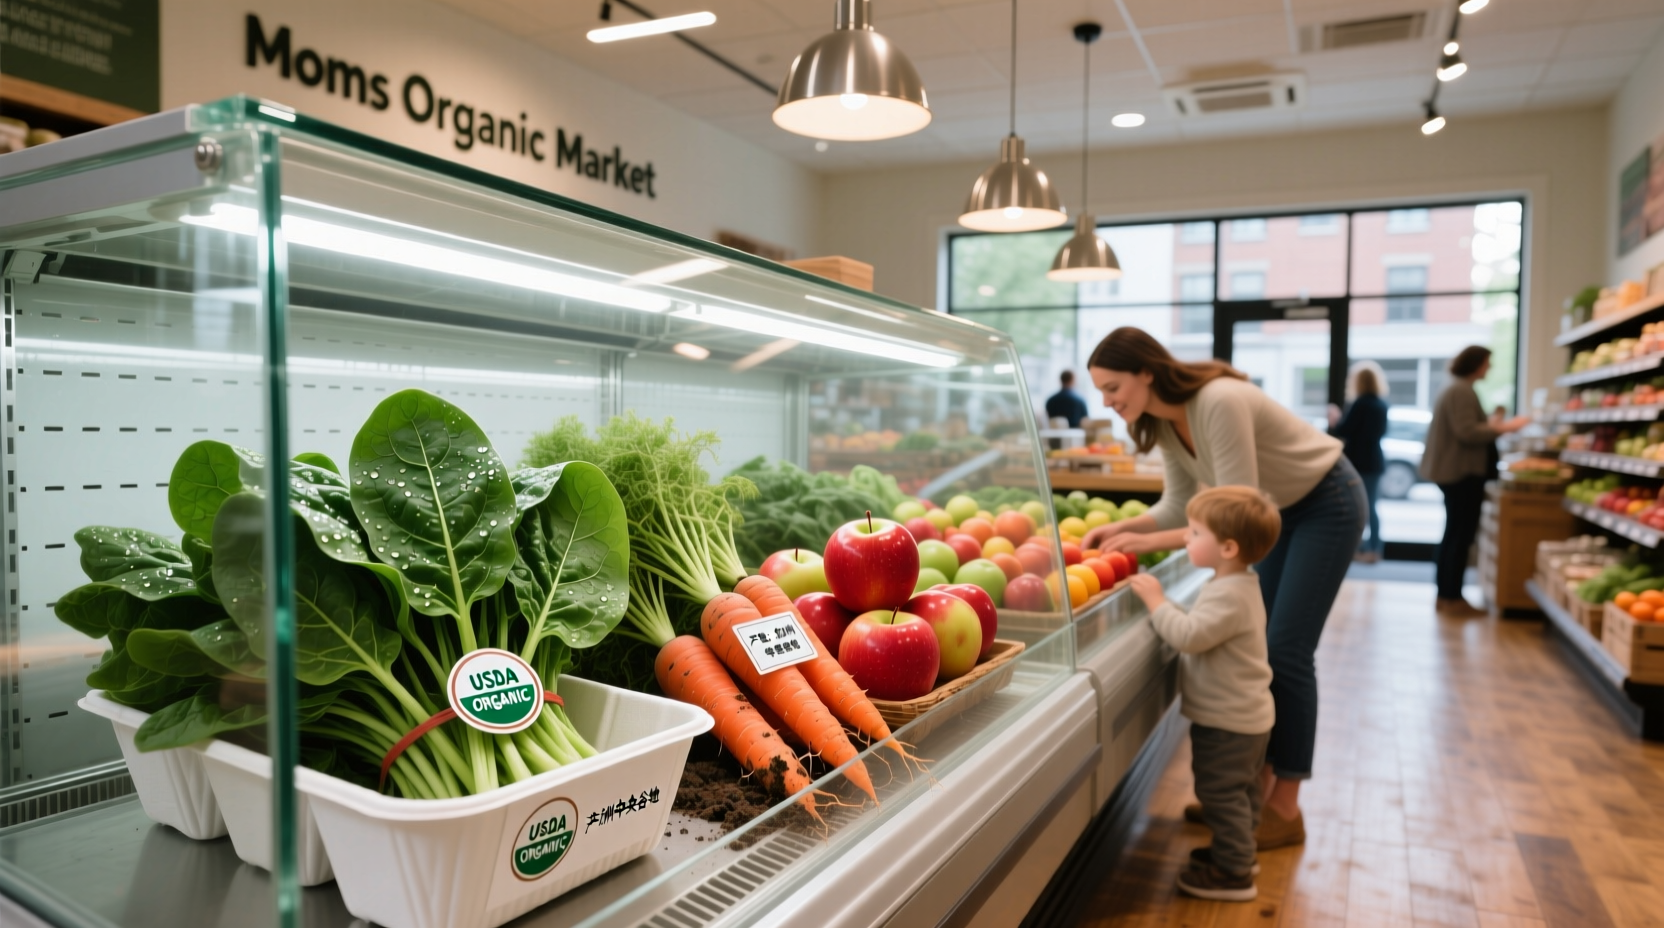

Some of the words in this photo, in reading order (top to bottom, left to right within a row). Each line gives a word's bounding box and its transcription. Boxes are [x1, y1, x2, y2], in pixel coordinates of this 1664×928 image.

[244, 12, 391, 112] Moms
[401, 73, 546, 162] Organic
[556, 127, 657, 199] Market
[469, 667, 519, 690] USDA
[472, 688, 531, 711] ORGANIC
[529, 814, 566, 841] USDA
